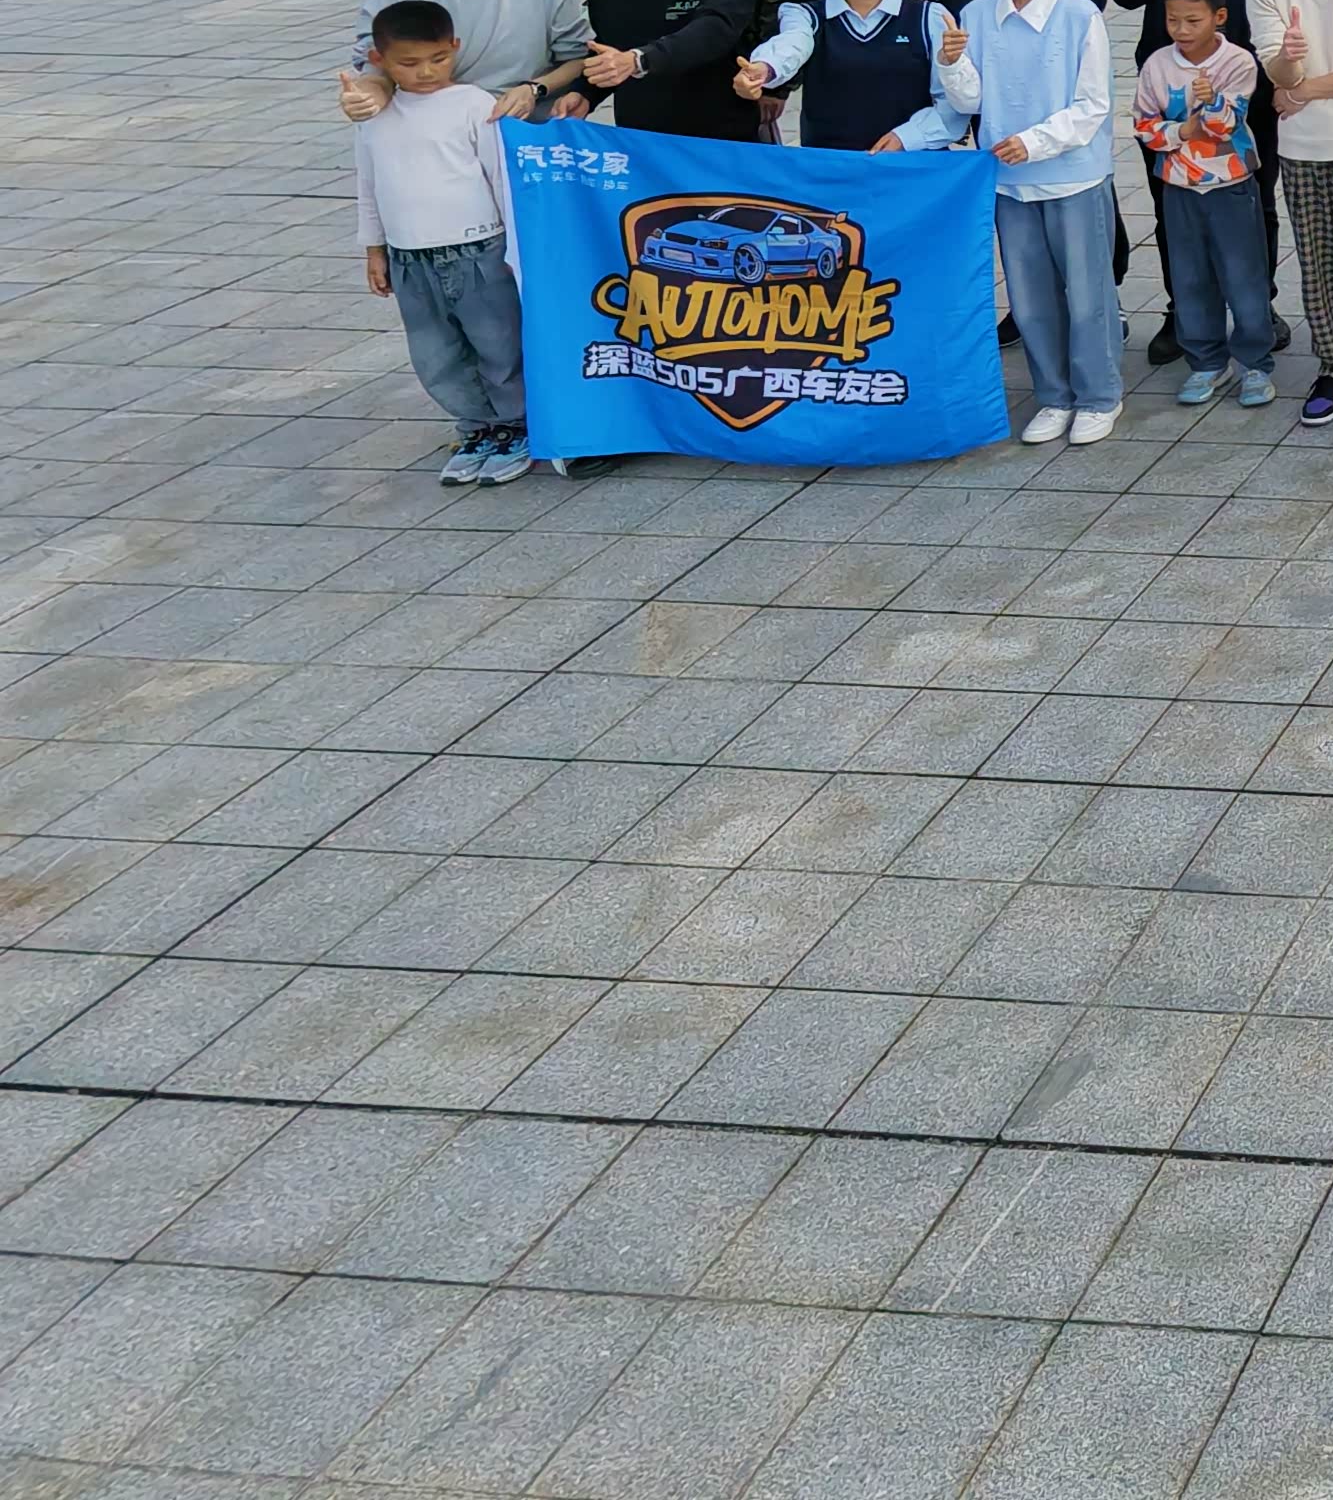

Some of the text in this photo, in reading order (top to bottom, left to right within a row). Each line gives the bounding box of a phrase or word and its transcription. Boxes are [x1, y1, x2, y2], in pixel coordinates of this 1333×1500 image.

[516, 143, 631, 176] 汽车之家
[594, 268, 898, 358] AUTOHOME
